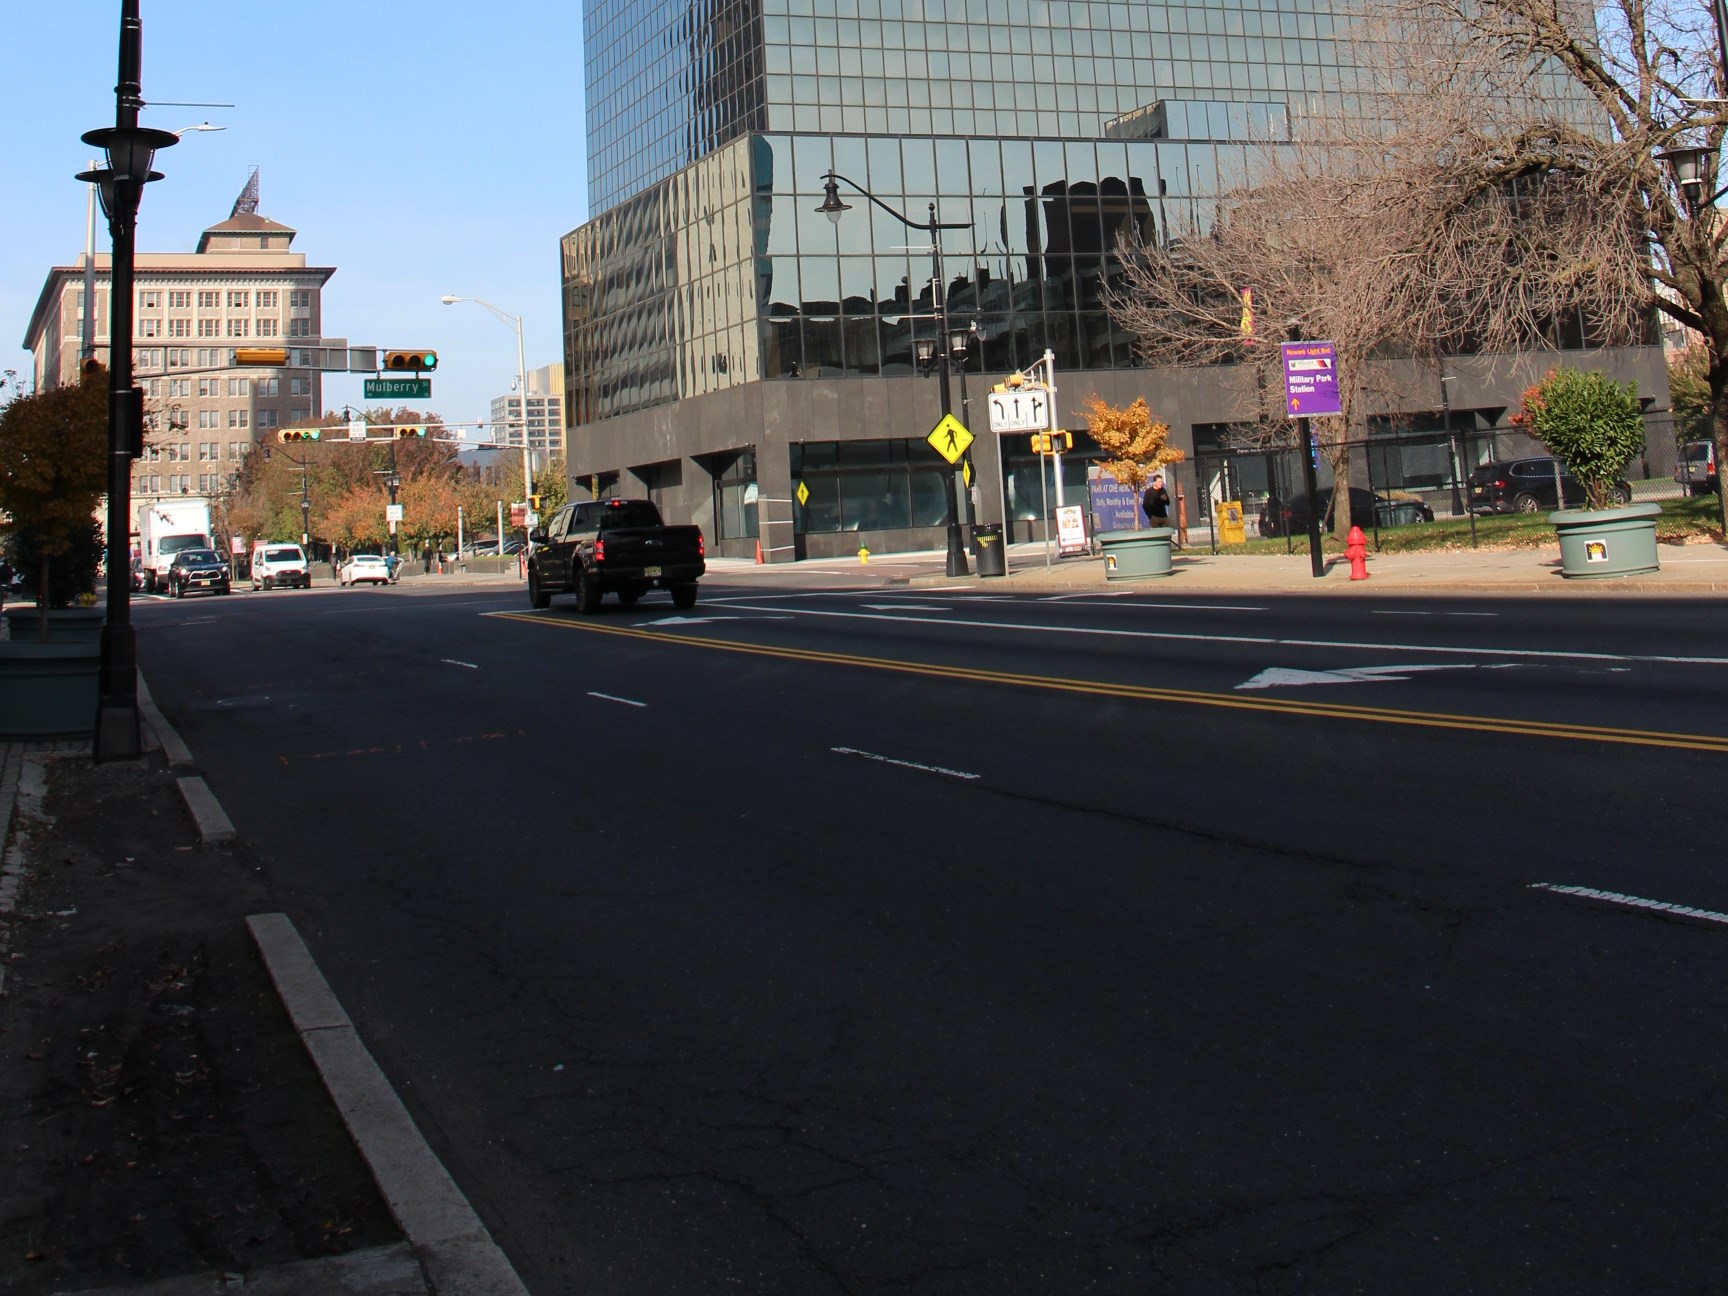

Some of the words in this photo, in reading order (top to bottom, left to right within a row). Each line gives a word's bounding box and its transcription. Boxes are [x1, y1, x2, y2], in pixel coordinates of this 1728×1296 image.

[1289, 376, 1314, 384] Military
[366, 382, 418, 394] Mulberry
[1290, 385, 1315, 393] Station
[1108, 484, 1118, 493] ONE
